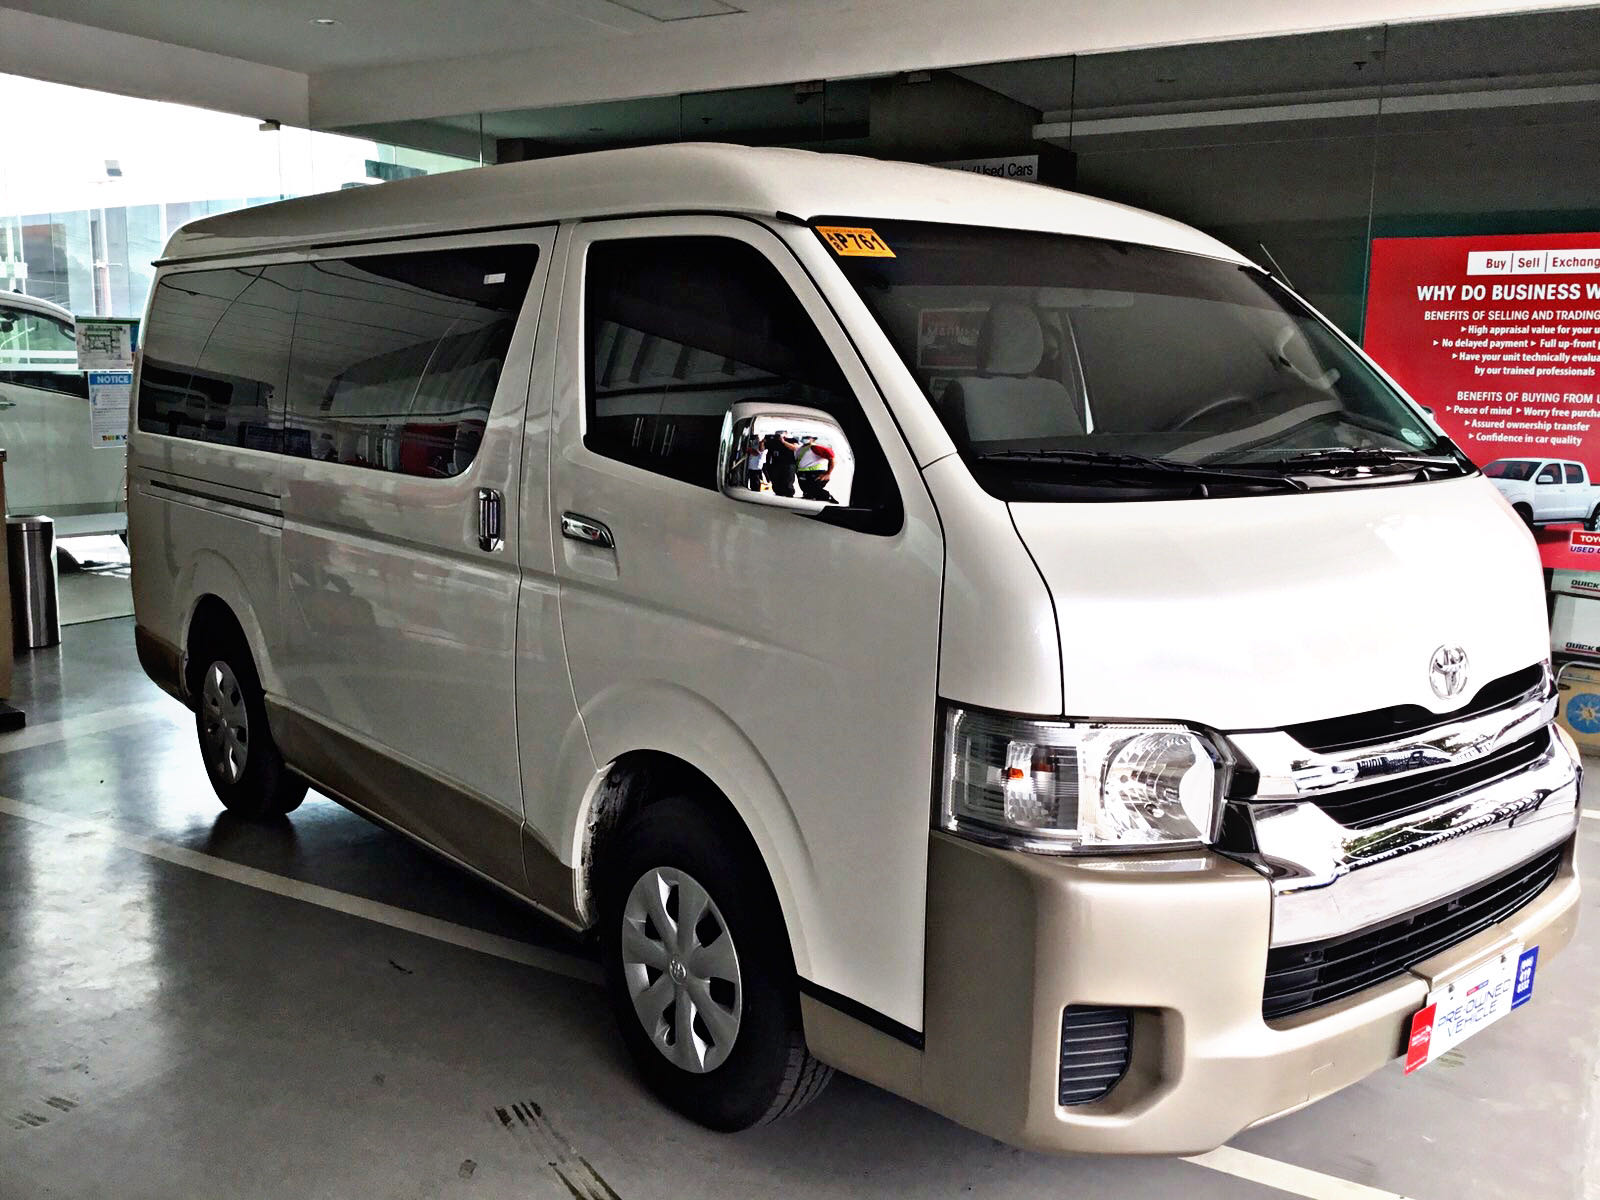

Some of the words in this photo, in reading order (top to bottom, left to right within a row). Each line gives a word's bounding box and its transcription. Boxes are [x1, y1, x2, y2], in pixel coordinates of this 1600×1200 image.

[1008, 162, 1033, 177] Cars
[1486, 258, 1506, 270] Buy
[1518, 257, 1540, 268] Sell
[1417, 285, 1456, 300] WHY
[1461, 285, 1486, 300] DO
[1492, 283, 1581, 300] BUSINESS
[1424, 310, 1469, 321] BENEFITS
[1472, 310, 1486, 321] OF
[1488, 310, 1529, 321] SELLING
[1531, 310, 1554, 321] AND
[1556, 310, 1600, 321] TRADING
[1468, 325, 1488, 336] High
[1489, 325, 1530, 336] appraisal
[1531, 325, 1556, 334] value
[1557, 325, 1570, 334] for
[1572, 326, 1593, 336] your
[1442, 339, 1453, 347] No
[1455, 338, 1489, 349] delayed
[1490, 339, 1528, 349] payment
[1540, 339, 1556, 348] Full
[1558, 339, 1596, 350] up-front
[1459, 352, 1480, 361] Have
[1482, 353, 1501, 363] your
[1502, 352, 1520, 361] unit
[1522, 352, 1570, 363] technically
[1474, 365, 1485, 376] by
[1486, 367, 1502, 375] our
[1503, 366, 1535, 375] trained
[1536, 366, 1596, 377] professionals
[96, 375, 129, 384] NOTICE
[1457, 391, 1503, 401] BENEFITS
[1505, 392, 1519, 402] OF
[1521, 392, 1560, 403] BUYING
[1563, 393, 1594, 404] FROM
[1453, 405, 1478, 414] Peace
[1479, 405, 1489, 414] of
[1489, 406, 1513, 415] mind
[1523, 407, 1550, 418] Worry
[1551, 407, 1570, 417] free
[1471, 419, 1505, 429] Assured
[1506, 420, 1552, 432] ownership
[1554, 421, 1591, 431] transfer
[1476, 432, 1523, 443] Confidence
[1524, 433, 1533, 443] in
[1535, 435, 1549, 444] car
[1550, 434, 1583, 446] quality
[1580, 535, 1600, 543] TOY
[1570, 546, 1595, 554] USED
[1571, 579, 1600, 588] QUICK
[1566, 642, 1594, 651] QUICK
[1447, 999, 1498, 1037] VEHICLE
